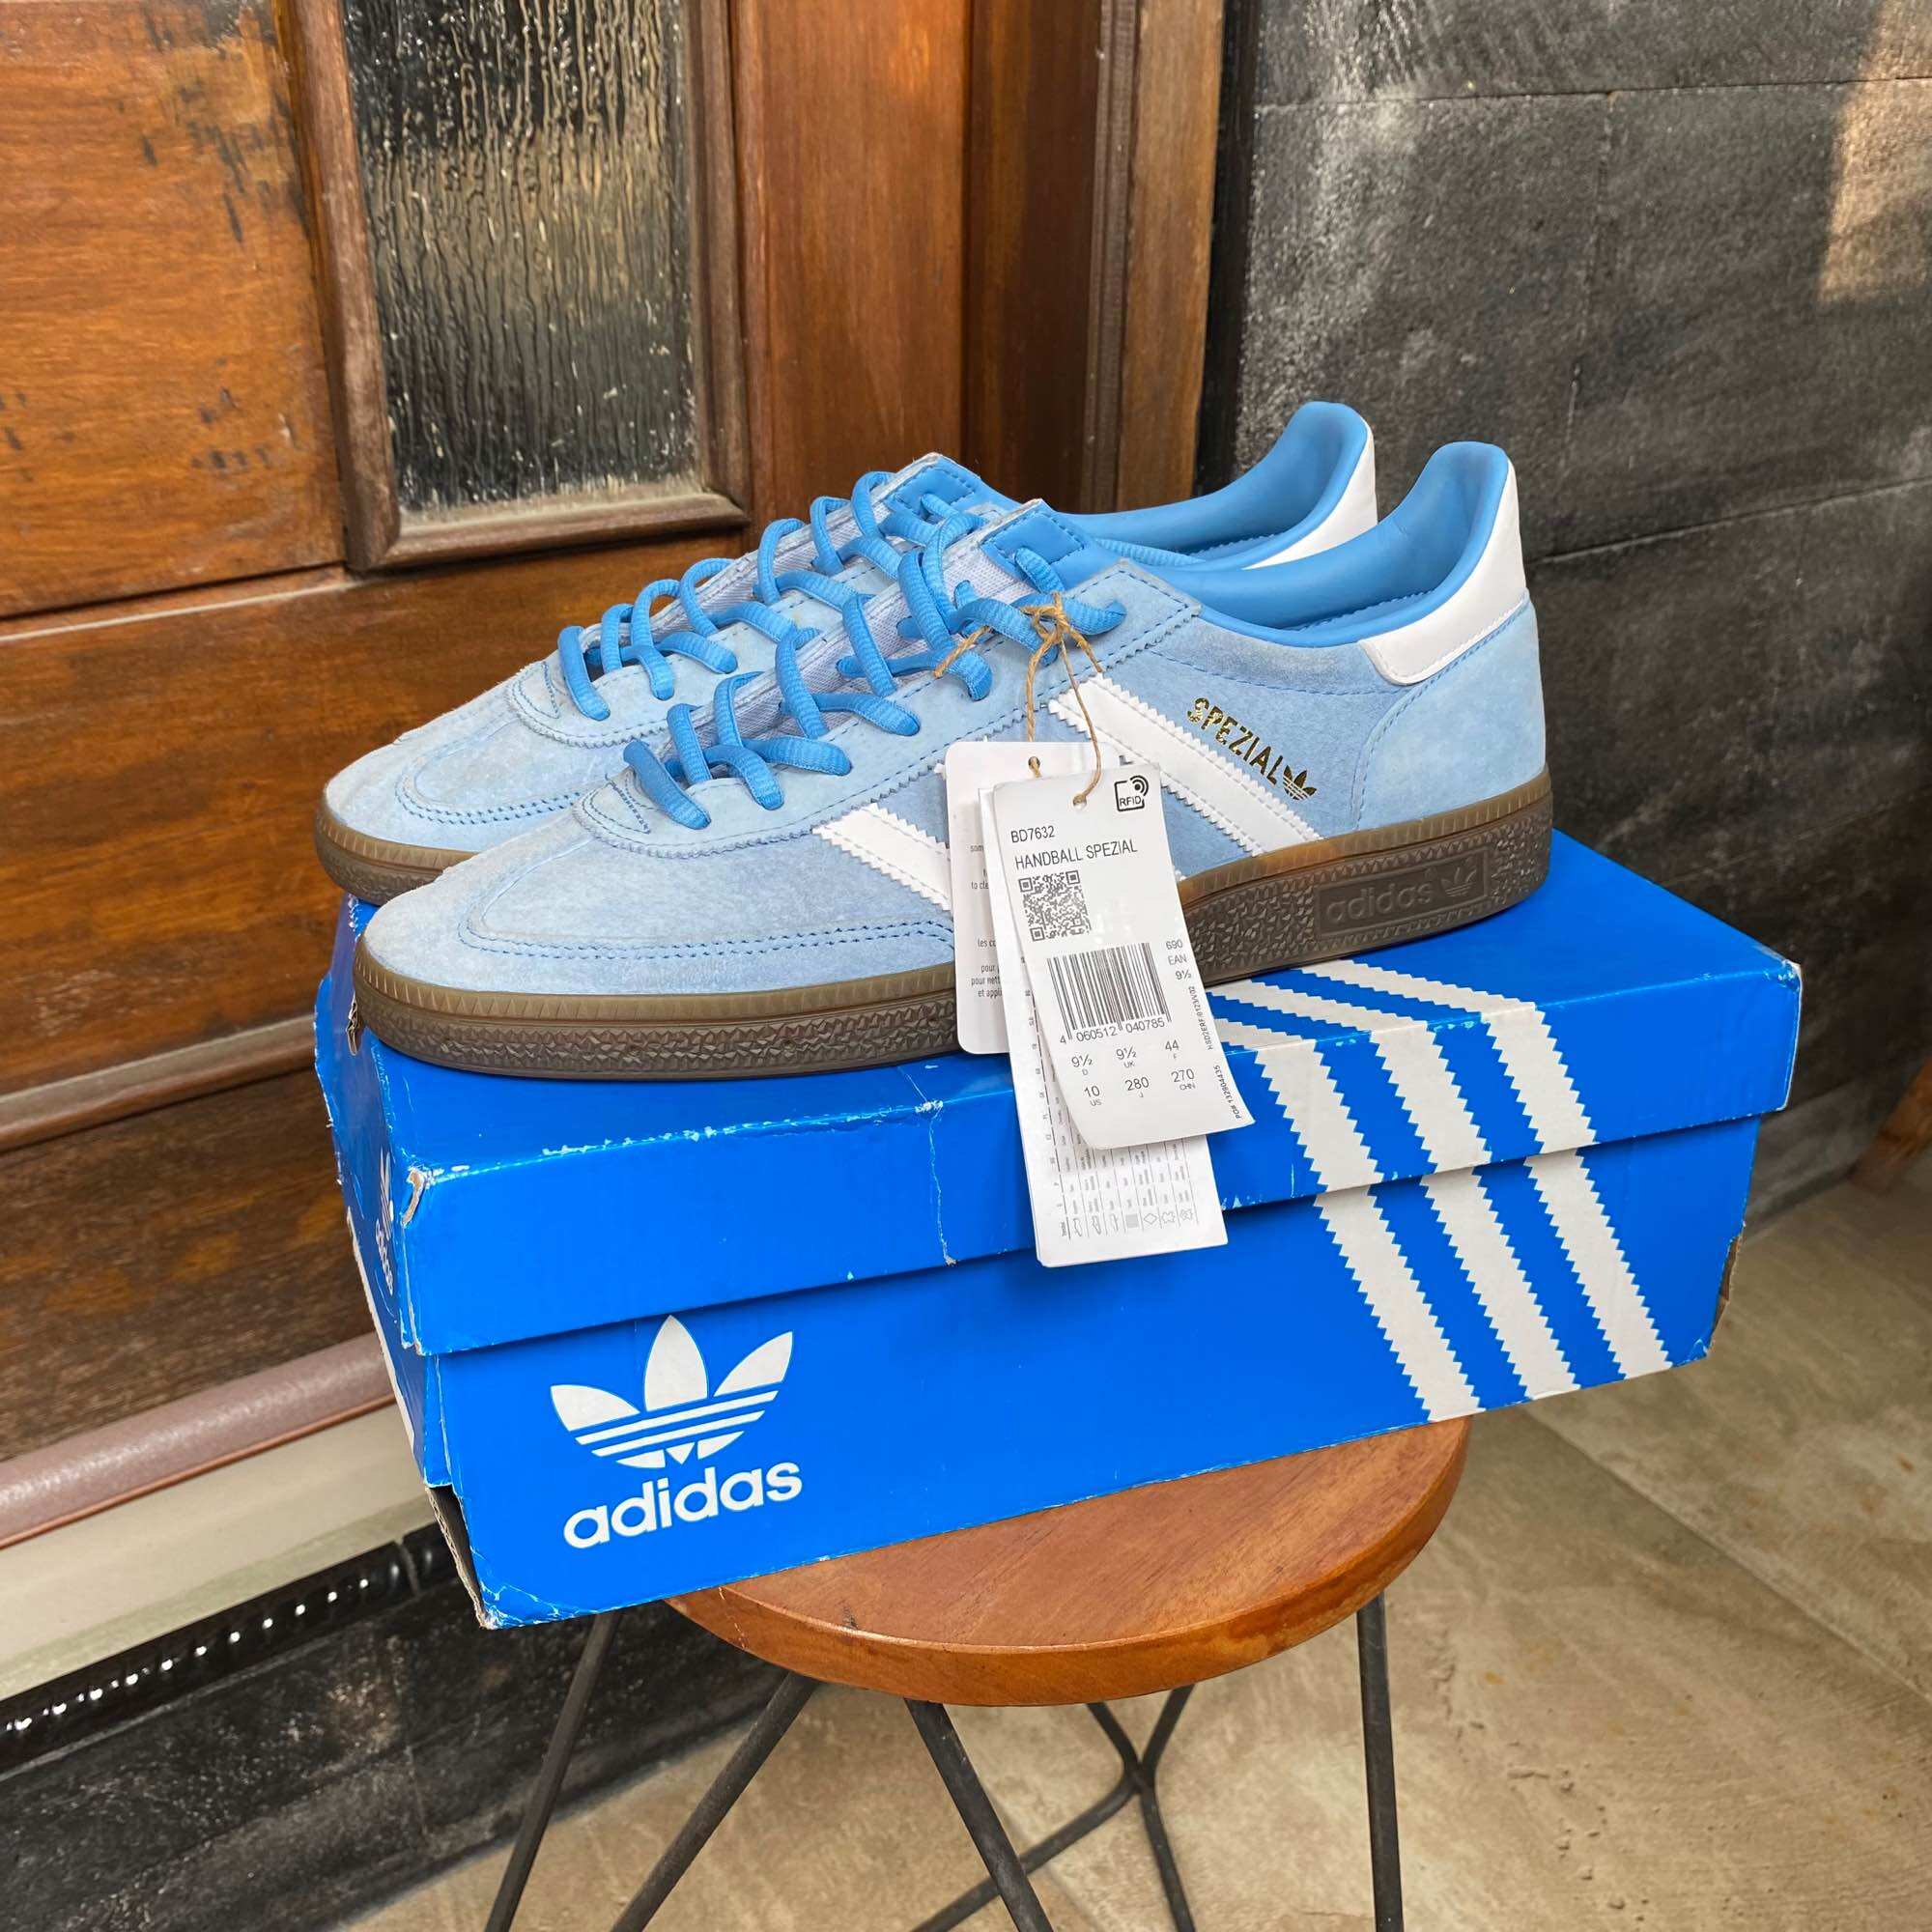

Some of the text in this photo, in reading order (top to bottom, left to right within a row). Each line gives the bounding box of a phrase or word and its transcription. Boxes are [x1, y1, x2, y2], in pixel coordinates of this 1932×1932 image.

[1186, 697, 1285, 785] SPEZIAL
[1120, 795, 1142, 808] RFID
[1010, 825, 1056, 843] BD7632
[1015, 838, 1138, 870] HANDBALL SPEZIAL
[1324, 879, 1433, 924] adidas
[1165, 939, 1183, 951] 690
[1168, 953, 1187, 966] EAN
[1059, 1017, 1165, 1045] 4 060512 040785
[1165, 1039, 1179, 1052] 44
[1123, 1060, 1135, 1068] UK
[1084, 1068, 1195, 1097] 10 280 270
[1090, 1098, 1102, 1107] US
[1179, 1083, 1197, 1092] CHN
[563, 1462, 803, 1549] adidas
